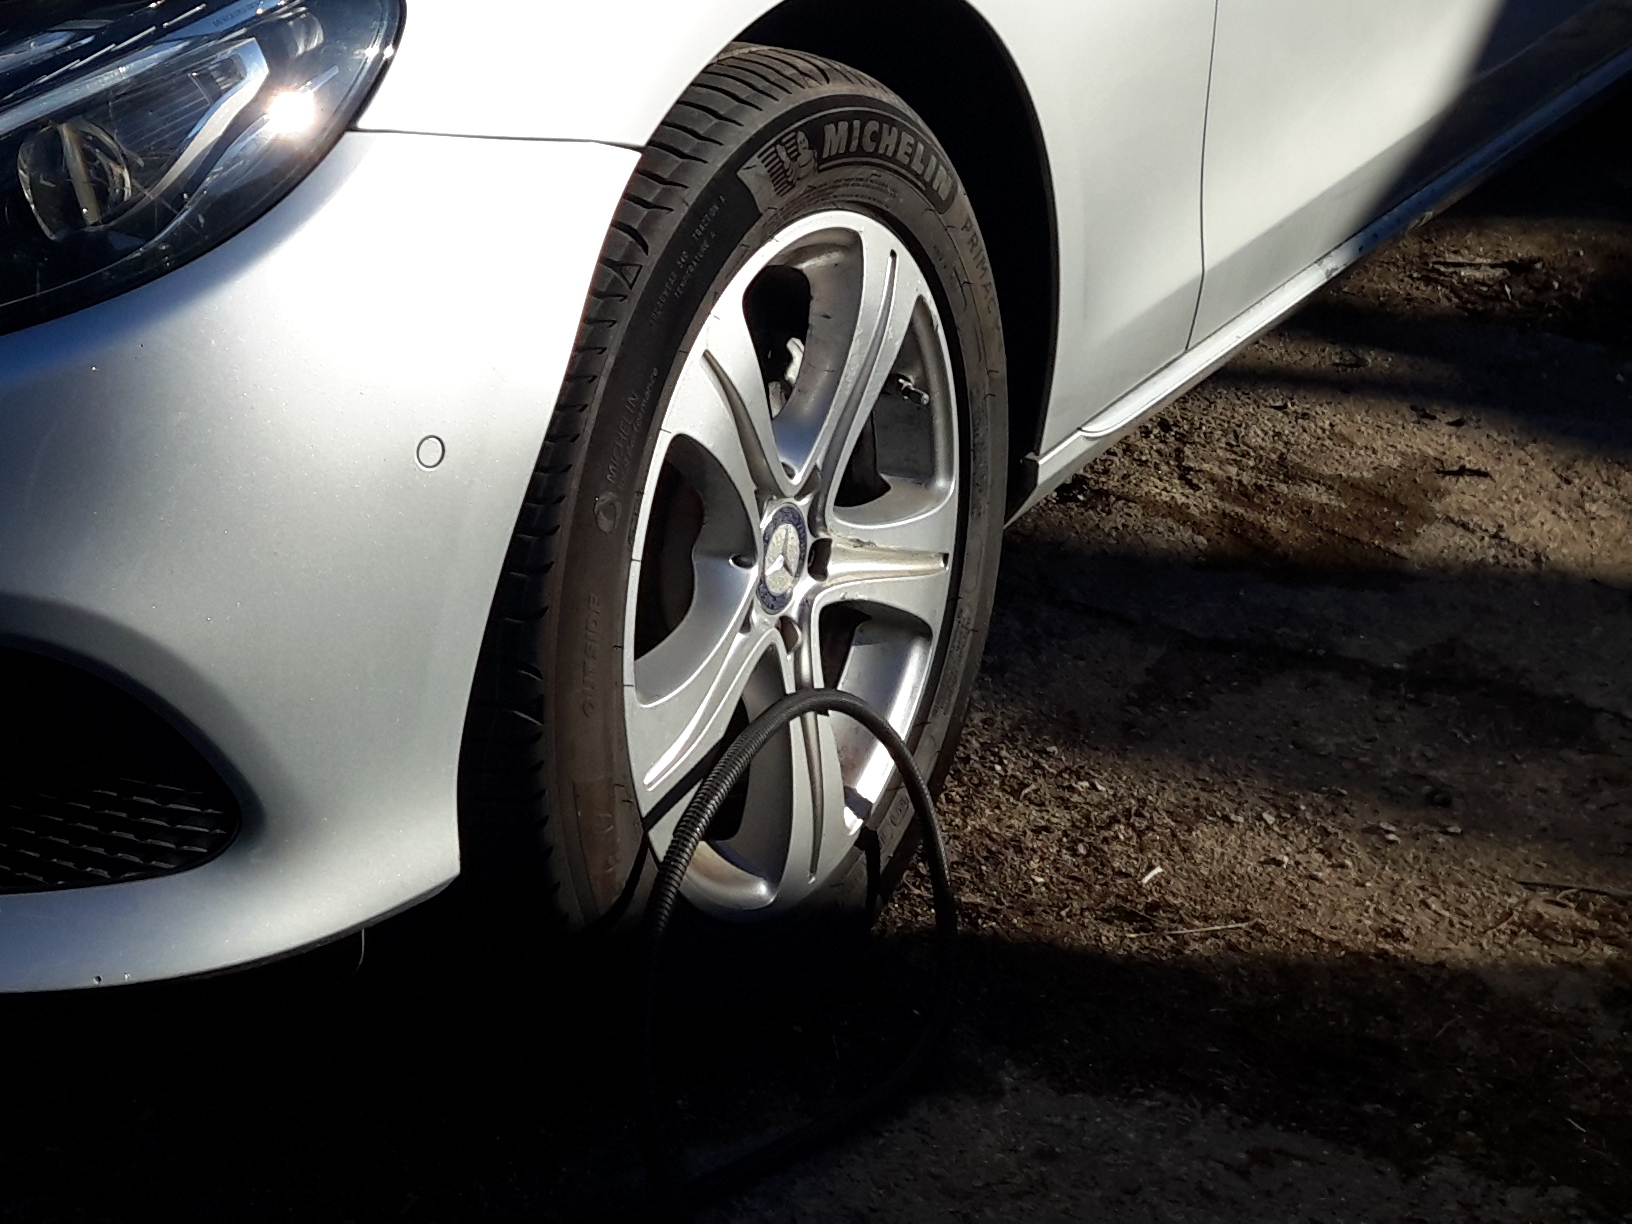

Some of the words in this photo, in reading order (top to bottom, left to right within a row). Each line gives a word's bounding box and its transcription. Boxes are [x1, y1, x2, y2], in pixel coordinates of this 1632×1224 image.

[821, 119, 957, 199] MICHELIN
[606, 391, 640, 485] MICHELIN
[581, 592, 603, 718] OUTSIDE
